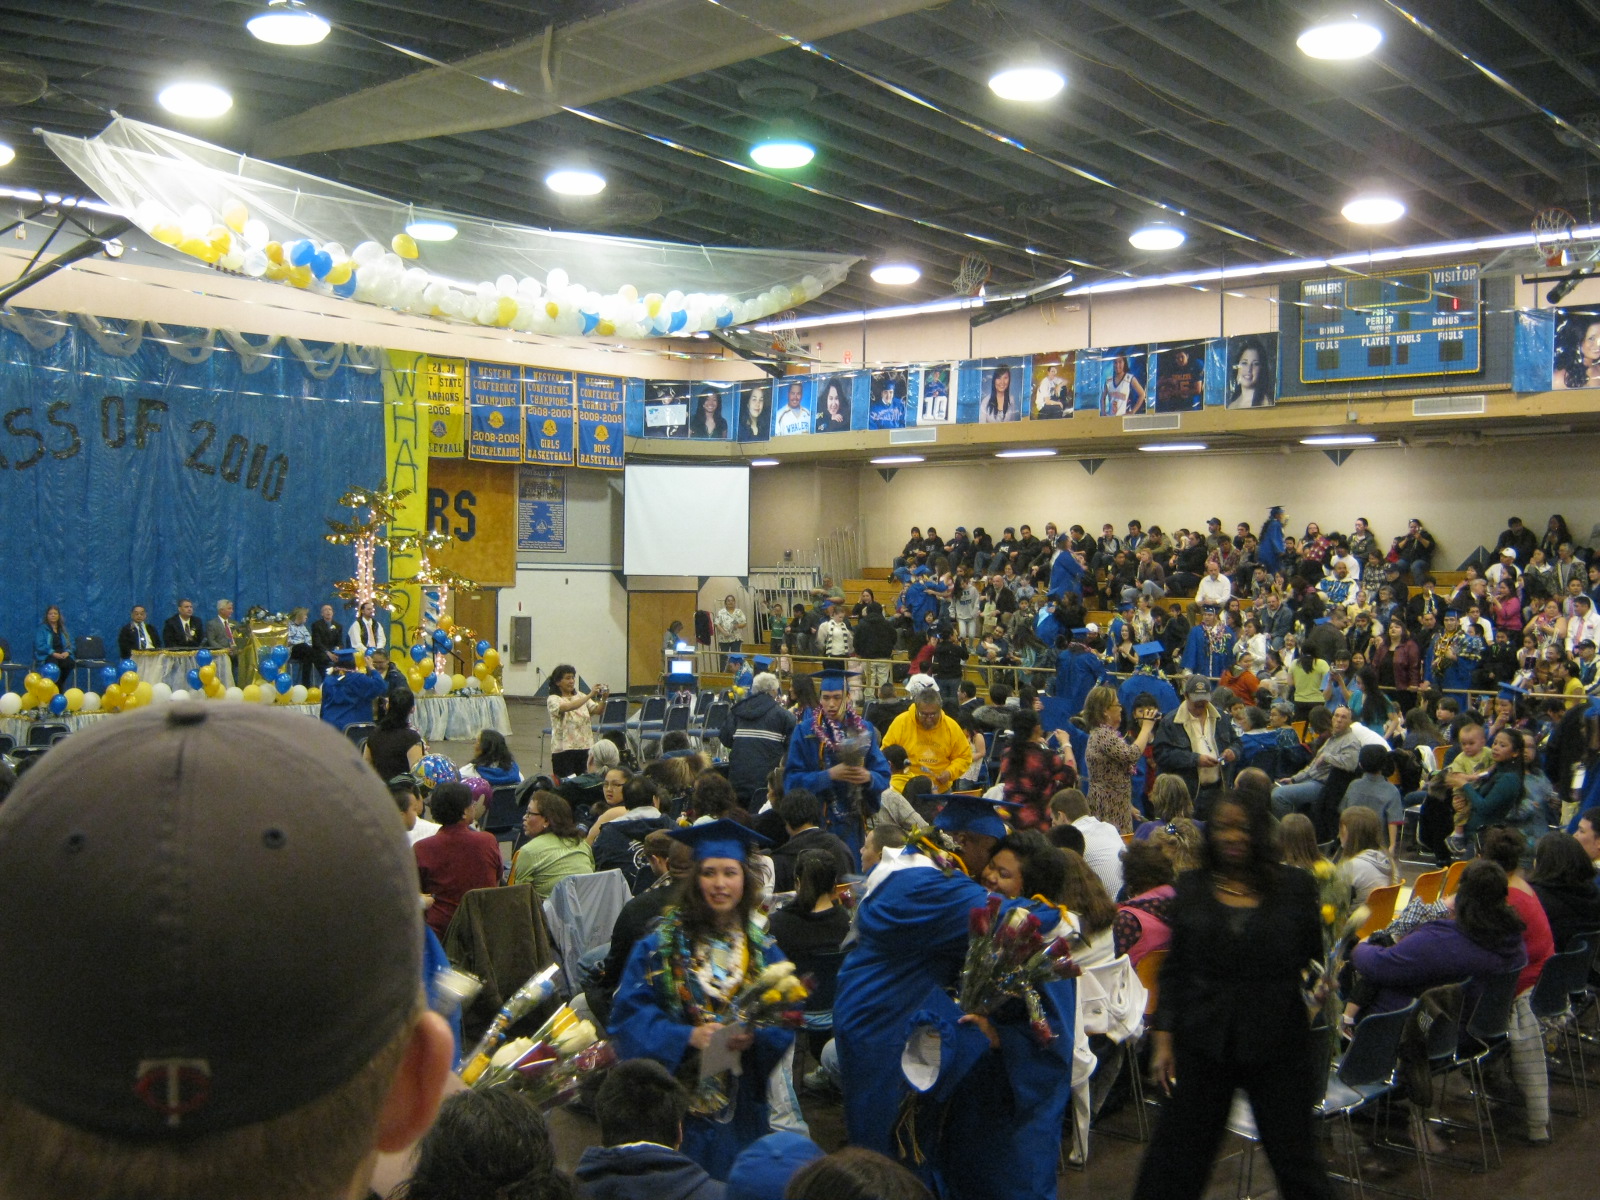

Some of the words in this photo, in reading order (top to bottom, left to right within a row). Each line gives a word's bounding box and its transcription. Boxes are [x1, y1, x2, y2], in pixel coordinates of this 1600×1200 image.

[1433, 268, 1477, 284] VISITOR
[1304, 282, 1343, 296] WHALERS
[1365, 315, 1394, 326] PERIOD
[1432, 316, 1459, 326] BONUS
[1319, 325, 1345, 336] BONUS
[1437, 331, 1463, 341] FOULS
[1315, 340, 1339, 351] FOULS
[1361, 336, 1390, 347] PLAYER
[1396, 333, 1421, 344] FOULS
[478, 366, 512, 379] WESTERN
[533, 371, 564, 382] WESTERN
[440, 377, 462, 388] STATE
[473, 380, 518, 393] CONFERENCE
[585, 377, 615, 389] WESTERN
[527, 383, 570, 395] CONFERENCE
[580, 388, 620, 401] CONFERENCE
[475, 394, 516, 407] CHAMPIONS
[529, 395, 569, 407] CHAMPIONS
[582, 400, 619, 412] RUNNER-UP
[428, 405, 451, 416] 2008
[527, 406, 572, 418] 2008-2009
[579, 411, 622, 424] 2008-2009
[472, 430, 520, 443] 2008-2009
[0, 401, 82, 471] SS
[101, 396, 169, 449] OF
[183, 419, 289, 502] 2010
[540, 439, 560, 449] GIRLS
[593, 443, 611, 454] BOYS
[471, 444, 520, 457] CHEERLEADING
[527, 449, 572, 461] BASKETBALL
[580, 454, 623, 466] BASKETBALL
